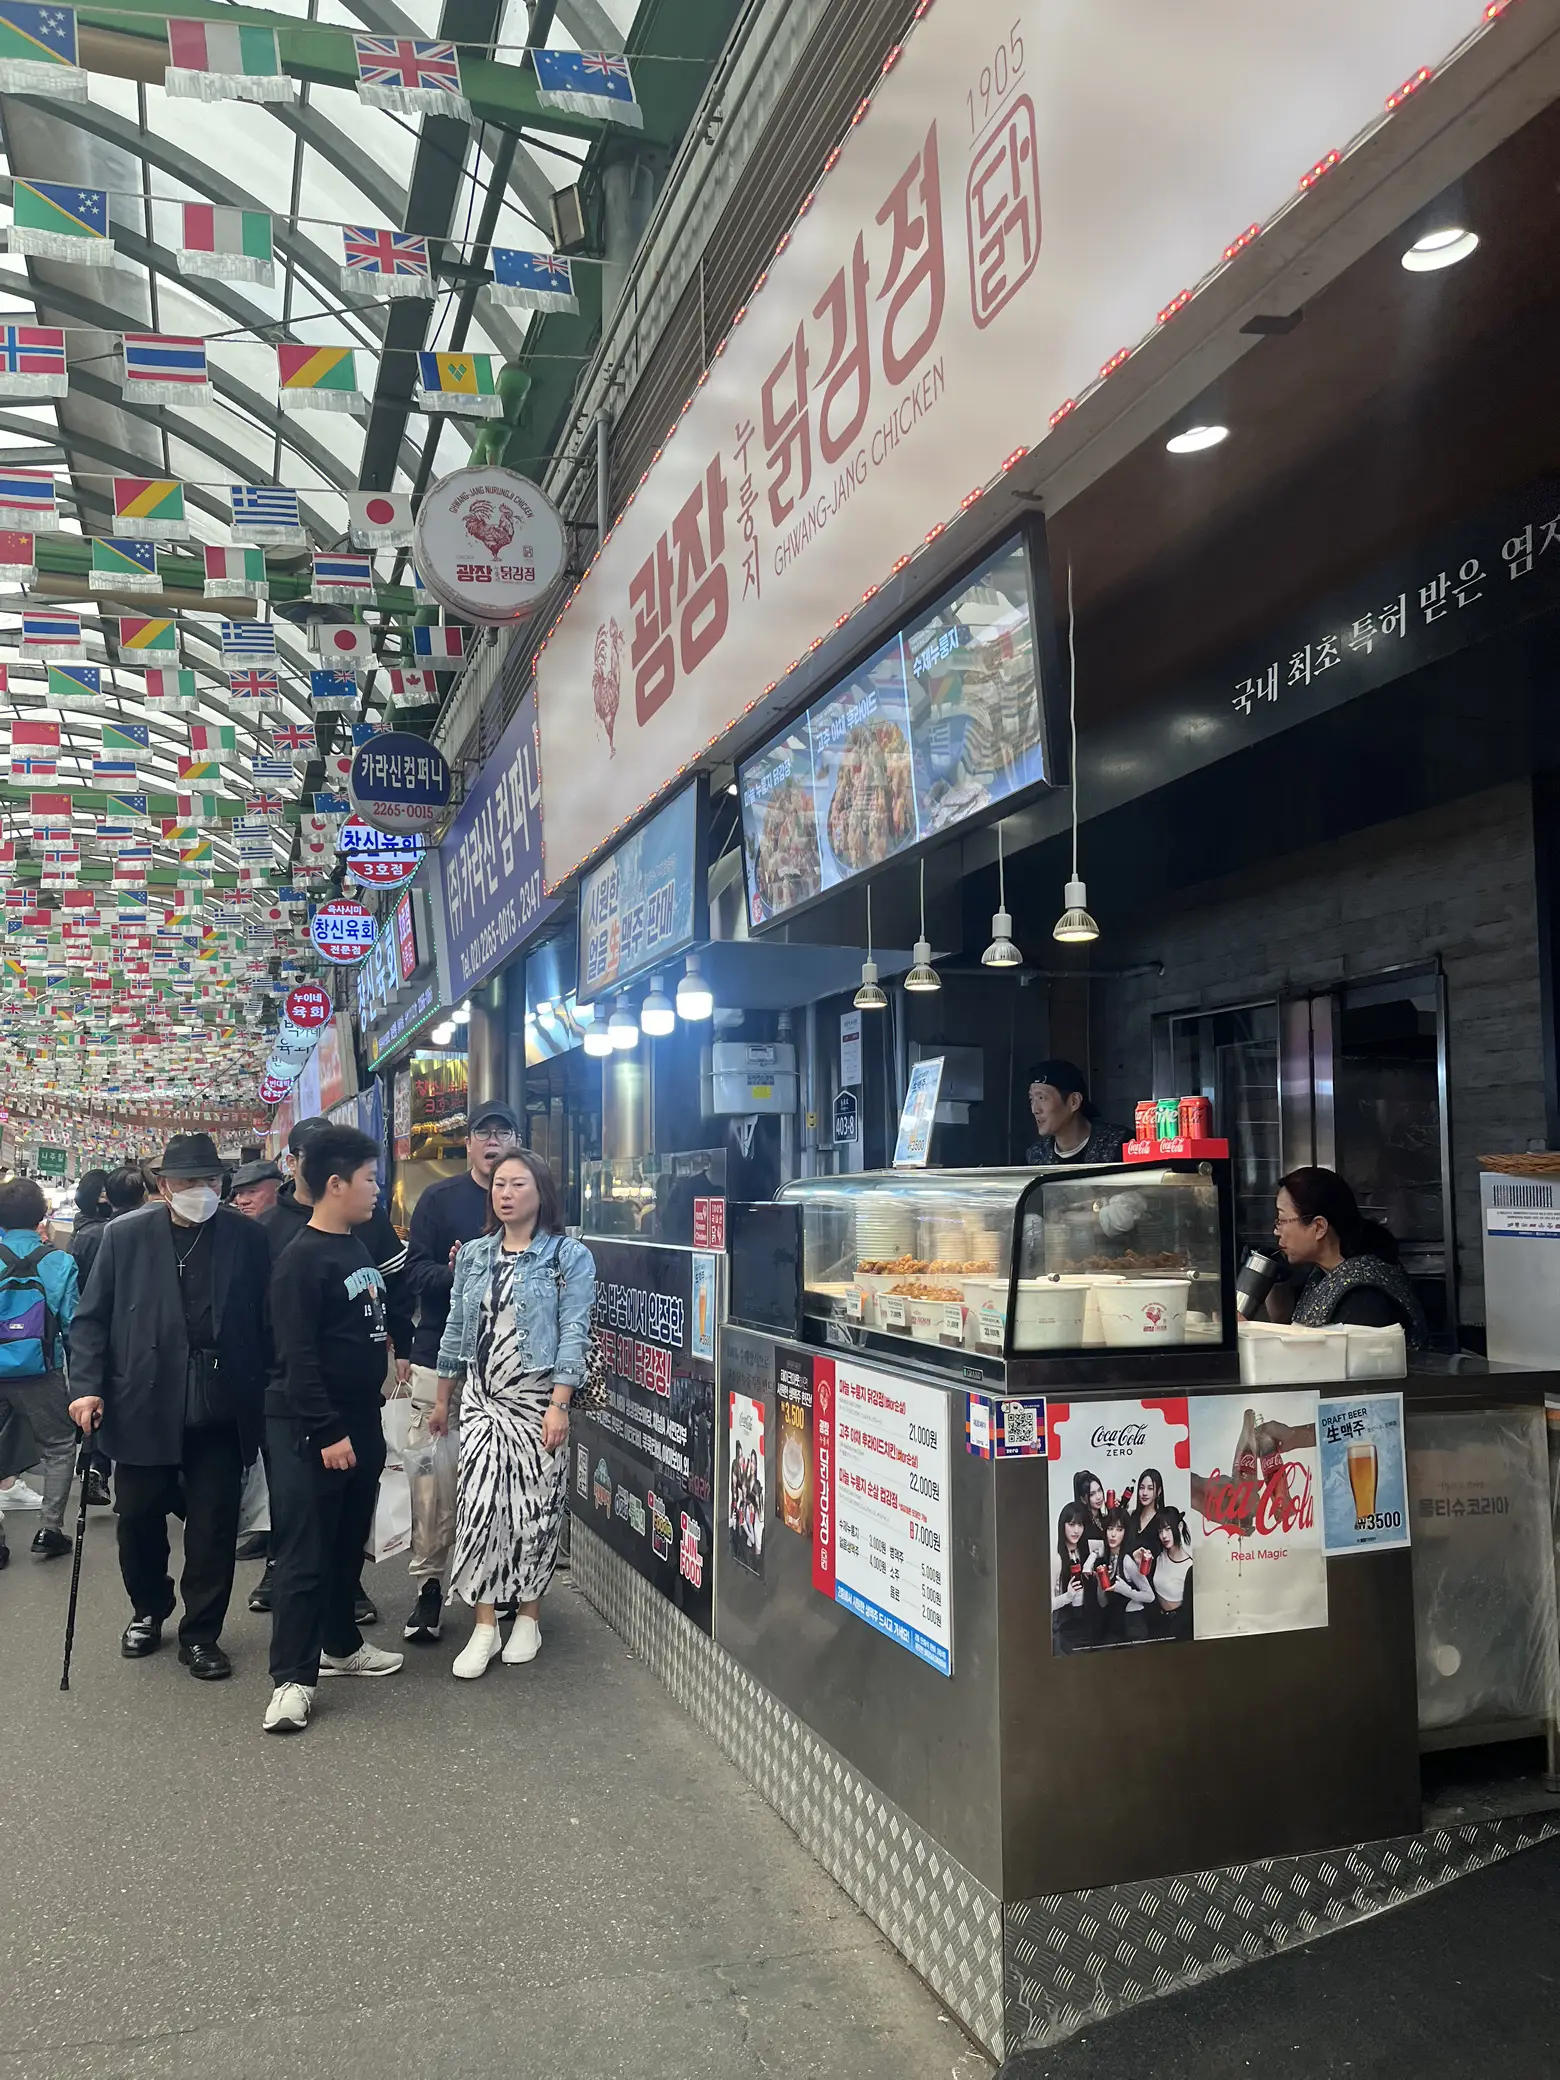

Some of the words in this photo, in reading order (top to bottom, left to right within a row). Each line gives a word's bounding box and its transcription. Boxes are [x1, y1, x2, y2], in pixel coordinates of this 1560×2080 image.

[967, 17, 1026, 132] 1905
[970, 130, 1032, 309] 닭
[629, 453, 730, 728] 광장
[760, 118, 948, 530] 닭강정
[774, 449, 868, 576] GHWANG-JANG
[870, 357, 947, 466] CHICKEN
[449, 485, 485, 515] GHWANG-JANG
[512, 495, 535, 519] CHICKEN
[733, 419, 762, 601] 누룽지
[456, 563, 493, 583] 광장
[500, 565, 535, 582] 닭강정
[1232, 662, 1279, 716] 국내
[1287, 634, 1342, 688] 최초
[1347, 593, 1407, 655] 특허
[1417, 557, 1487, 625] 받은
[912, 624, 959, 679] 수제누룽지
[815, 727, 831, 754] 고추
[846, 690, 878, 728] 후라이드
[361, 753, 443, 792] 카라신컴퍼니
[755, 772, 773, 799] 누룽지
[772, 756, 791, 788] 닭강정
[373, 802, 434, 819] 2265-0015
[363, 863, 403, 876] 3호점
[327, 905, 362, 915] 육사시미
[519, 868, 541, 925] 2347
[588, 864, 620, 934] 시원한
[646, 878, 676, 950] 판매
[315, 918, 375, 941] 창신육회
[330, 945, 361, 955] 전문점
[357, 917, 399, 1033] 창신육회
[293, 993, 323, 1003] 누이네
[835, 1115, 855, 1136] 403-8
[1128, 1139, 1151, 1155] Coca-Cola
[1160, 1138, 1185, 1154] Coca-Cola
[607, 1283, 648, 1337] 방송에서
[648, 1292, 684, 1348] 인정한
[616, 1334, 634, 1382] 3대
[634, 1339, 673, 1399] 닭강정!
[839, 1379, 850, 1397] 마늘
[850, 1382, 867, 1402] 누룽지
[1321, 1413, 1347, 1427] DRAFT
[1348, 1407, 1368, 1421] BEER
[1326, 1419, 1366, 1444] 生맥주
[839, 1423, 850, 1441] 고추
[1091, 1423, 1148, 1448] Coca-Cola
[1106, 1448, 1133, 1457] ZERO
[839, 1467, 850, 1486] 마늘
[850, 1472, 867, 1494] 누룽지
[867, 1481, 879, 1501] 순살
[879, 1486, 898, 1510] 컵강정
[1203, 1462, 1314, 1538] Coca-Cola
[839, 1518, 860, 1540] 수제누룽지
[1357, 1511, 1401, 1530] ₩3500
[680, 1551, 702, 1588] FOOD
[889, 1545, 905, 1565] 병맥주
[1231, 1550, 1255, 1562] Real
[1257, 1548, 1288, 1561] Magic
[890, 1567, 900, 1582] 소주
[879, 1610, 893, 1633] 드시고
[893, 1620, 911, 1643] 가세요!
